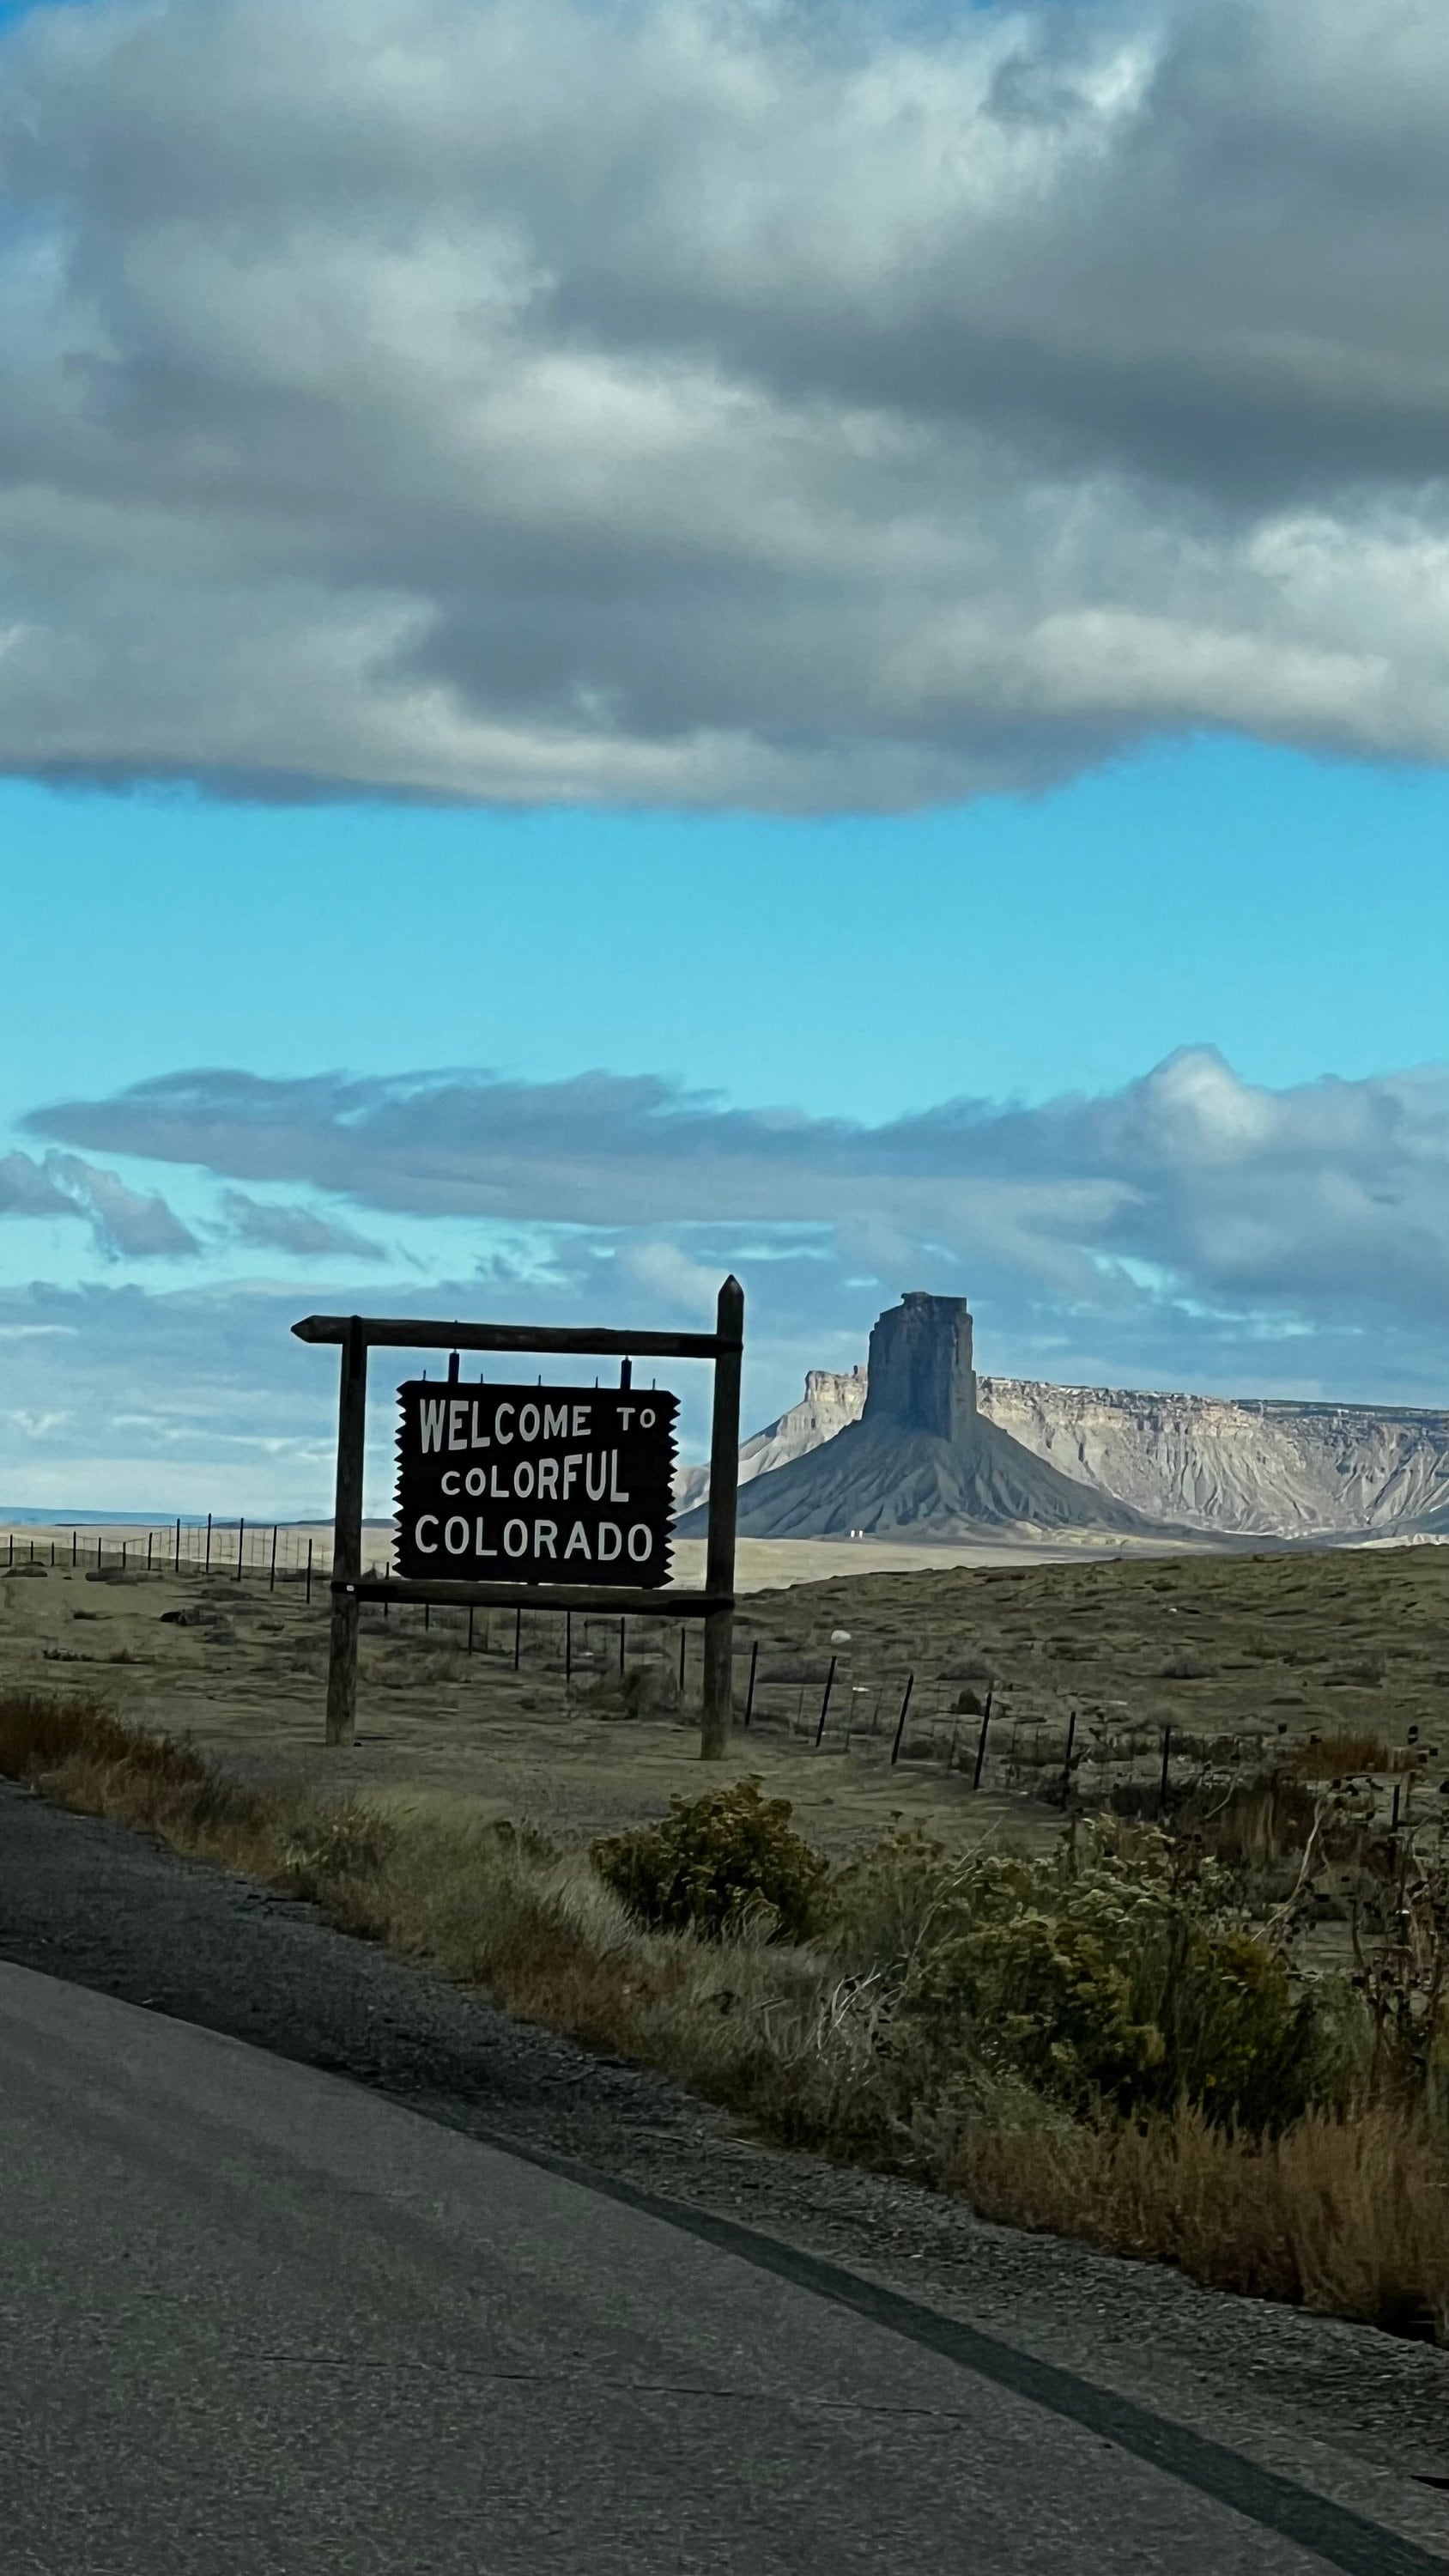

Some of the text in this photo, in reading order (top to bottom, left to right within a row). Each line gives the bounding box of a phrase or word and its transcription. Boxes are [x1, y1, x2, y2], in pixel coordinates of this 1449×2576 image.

[420, 1399, 656, 1454] WELCOME TO
[441, 1449, 630, 1503] COLORFUL
[415, 1515, 652, 1562] COLORADO
